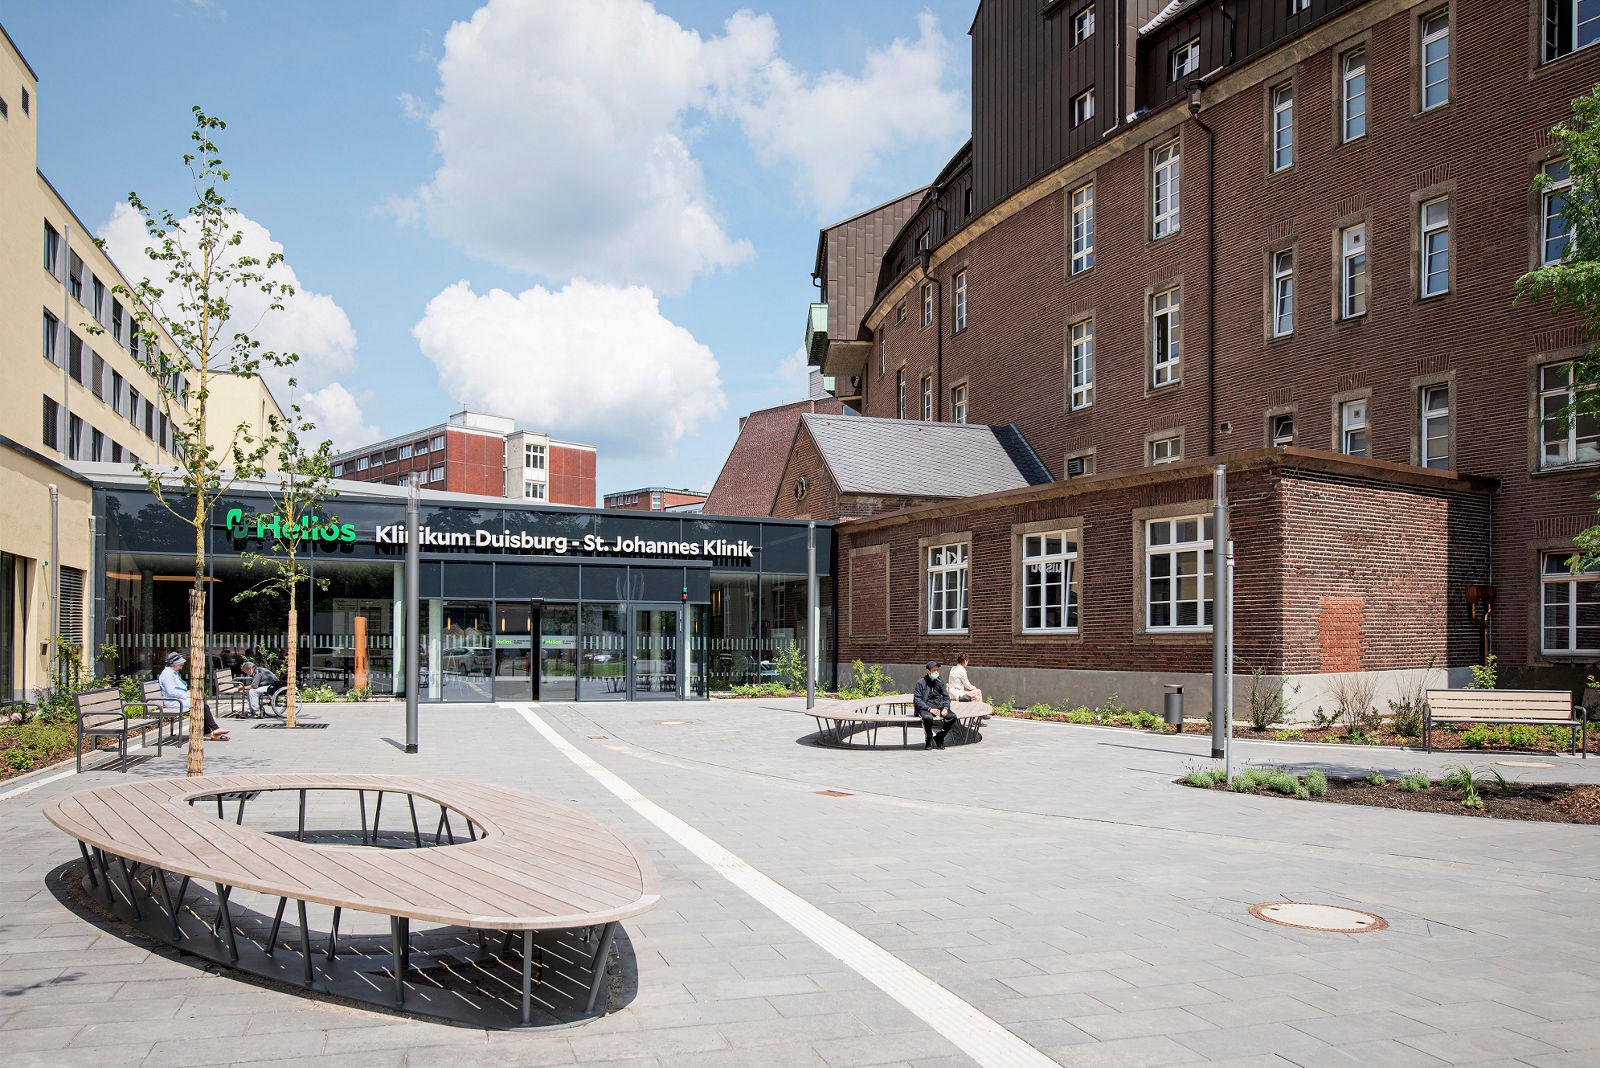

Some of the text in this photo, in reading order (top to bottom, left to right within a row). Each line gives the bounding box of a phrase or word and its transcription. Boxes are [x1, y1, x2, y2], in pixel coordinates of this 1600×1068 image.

[257, 515, 356, 542] Helios
[475, 529, 569, 554] Duisburg
[584, 534, 609, 552] St.
[612, 535, 700, 555] Johannes
[703, 539, 754, 557] Klinik
